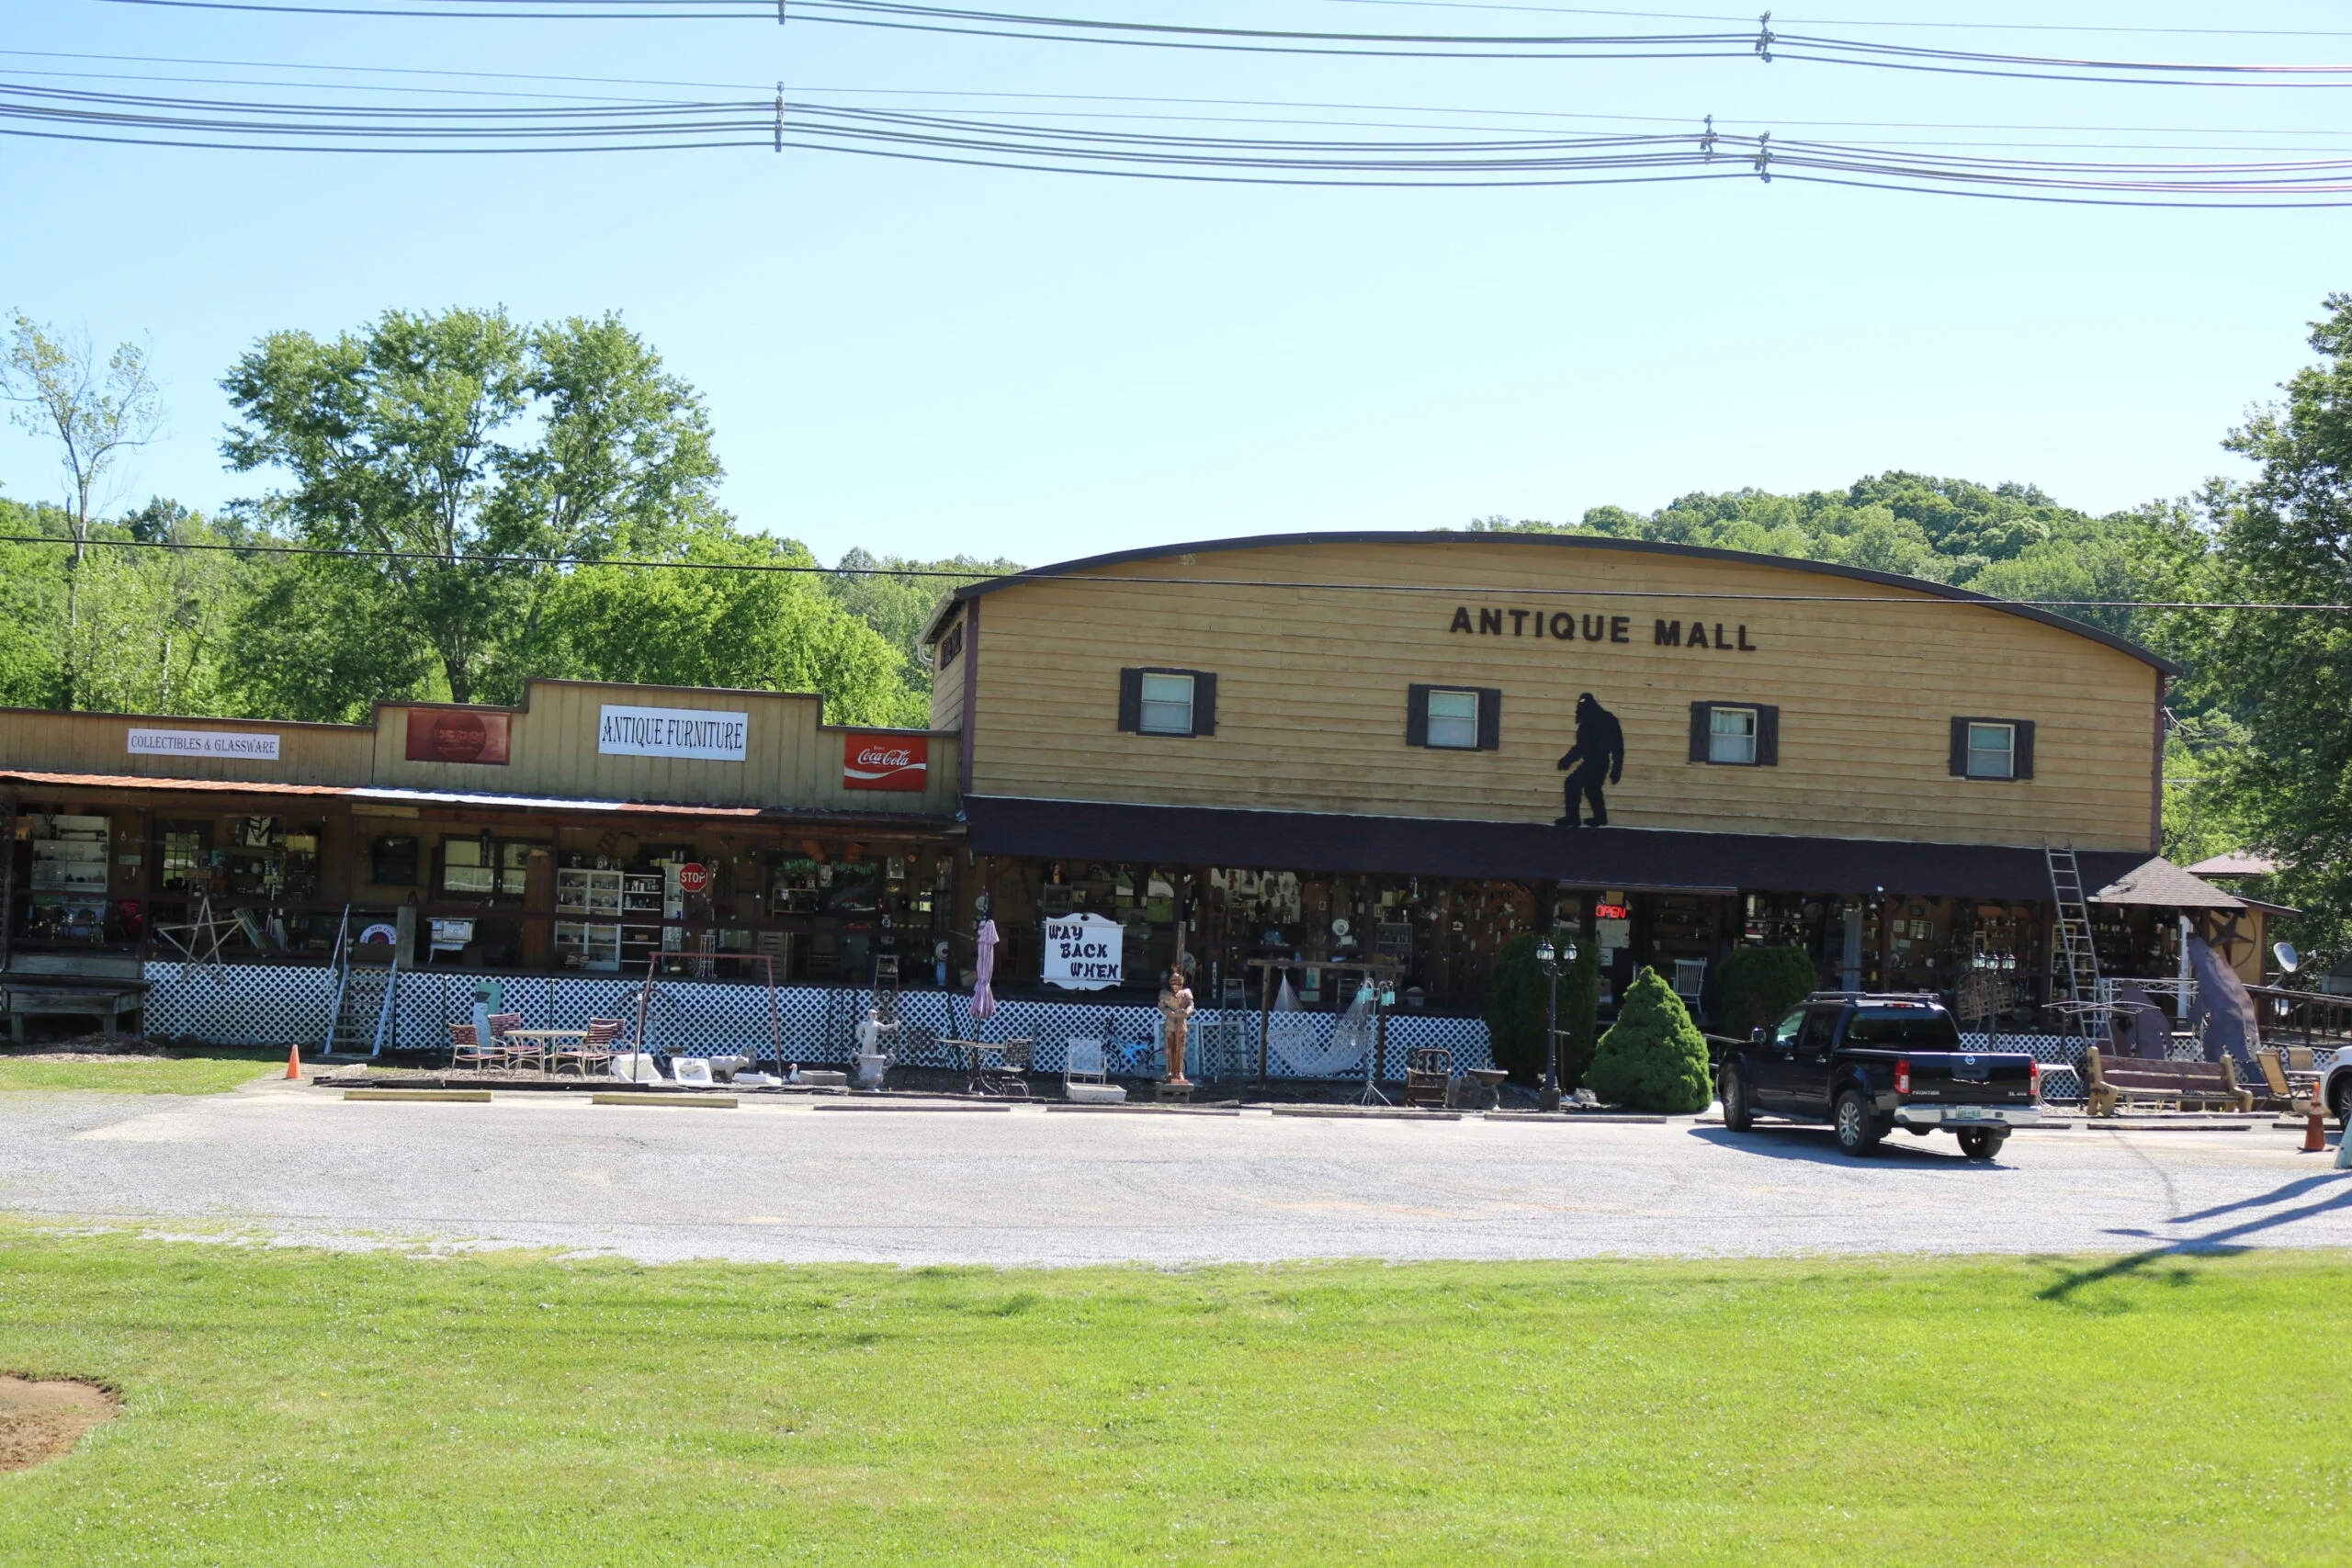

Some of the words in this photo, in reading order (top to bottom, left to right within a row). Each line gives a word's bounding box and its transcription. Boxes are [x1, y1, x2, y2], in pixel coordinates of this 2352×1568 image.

[1450, 606, 1630, 644] ANTIQUE
[1655, 619, 1757, 651] MALL
[602, 716, 663, 748] ANTIQUE
[667, 719, 743, 750] FURNITURE
[130, 735, 201, 750] COLLECTIBLES
[204, 739, 211, 750] &
[214, 739, 276, 754] GLASSWARE
[681, 872, 706, 883] STOP
[1595, 905, 1627, 919] OPEN
[1048, 924, 1083, 941] WAY
[1059, 942, 1108, 958] BACK
[1070, 962, 1119, 978] WHEN
